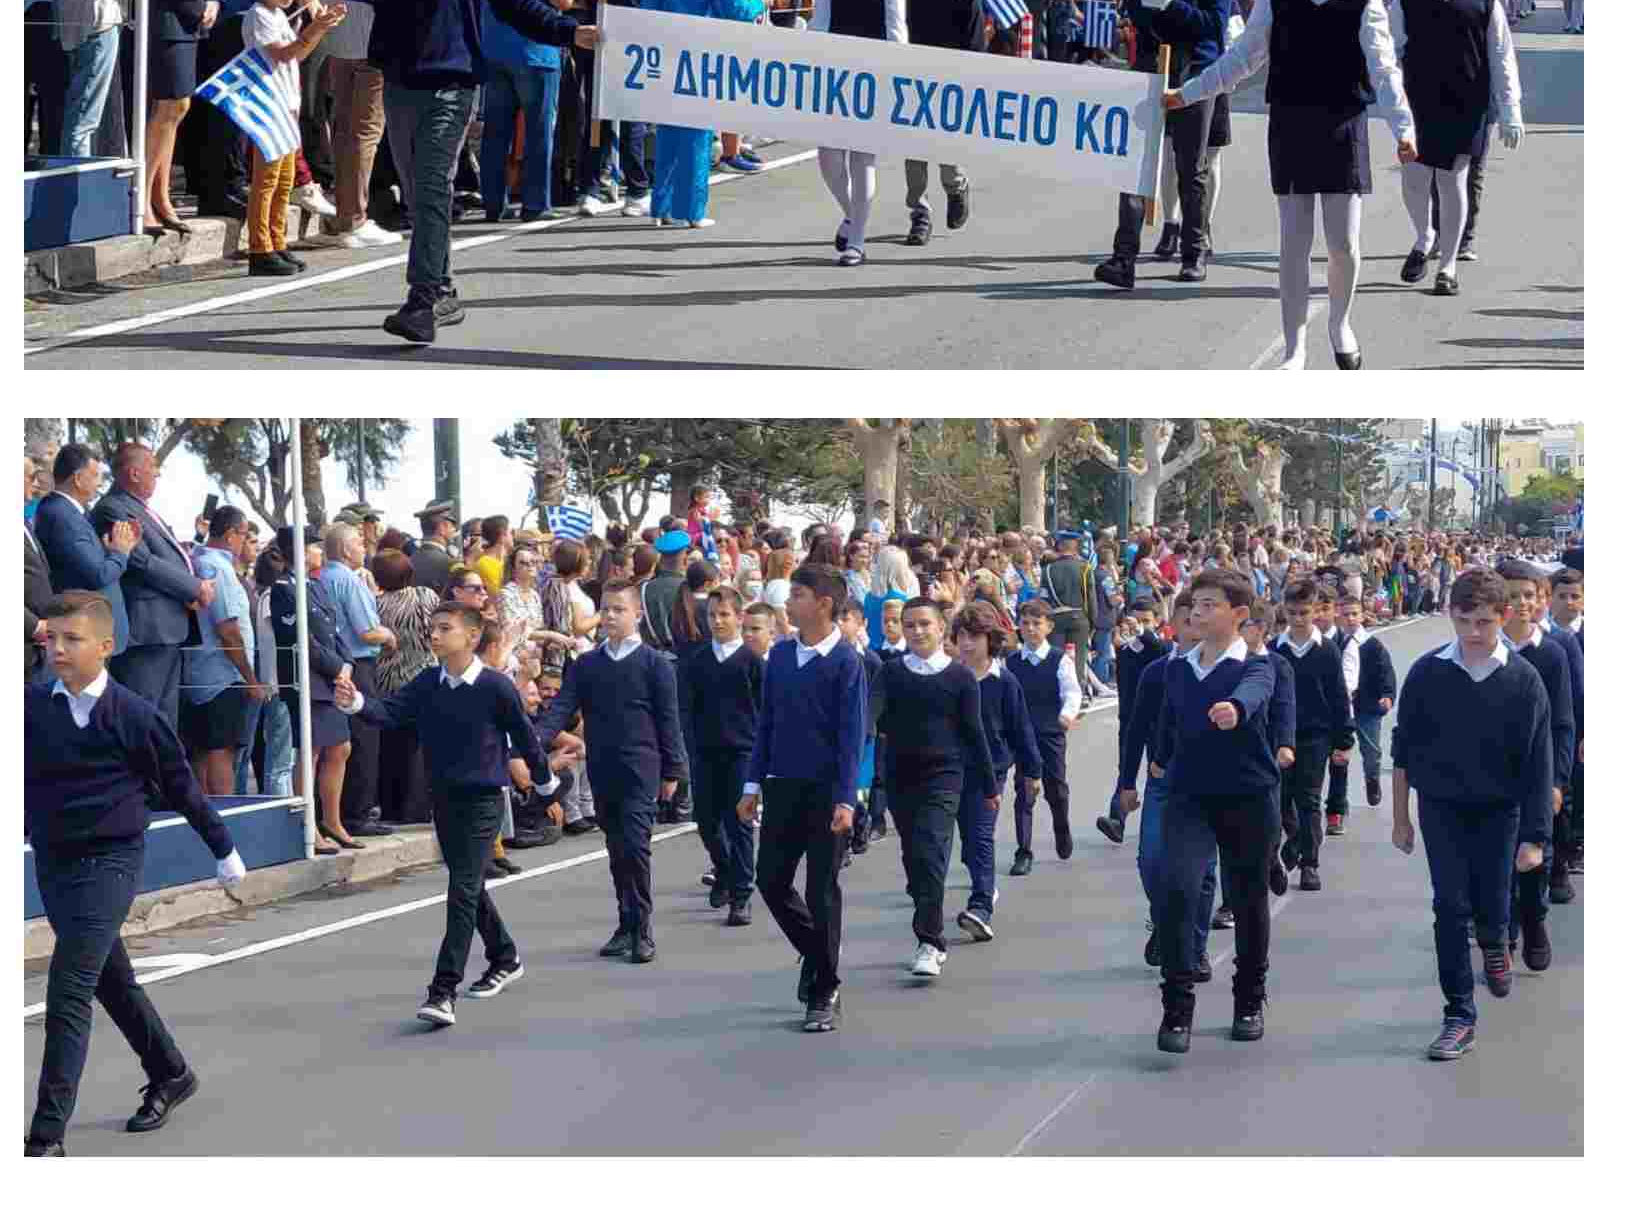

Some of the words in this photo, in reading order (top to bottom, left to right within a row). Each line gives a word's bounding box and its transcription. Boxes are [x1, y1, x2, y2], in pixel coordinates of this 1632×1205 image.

[673, 49, 877, 121] ΔΗΜΟΤΙΚΟ
[890, 76, 1058, 146] ΣΧΟΛΕΙΟ
[1075, 102, 1129, 155] ΚΩ
